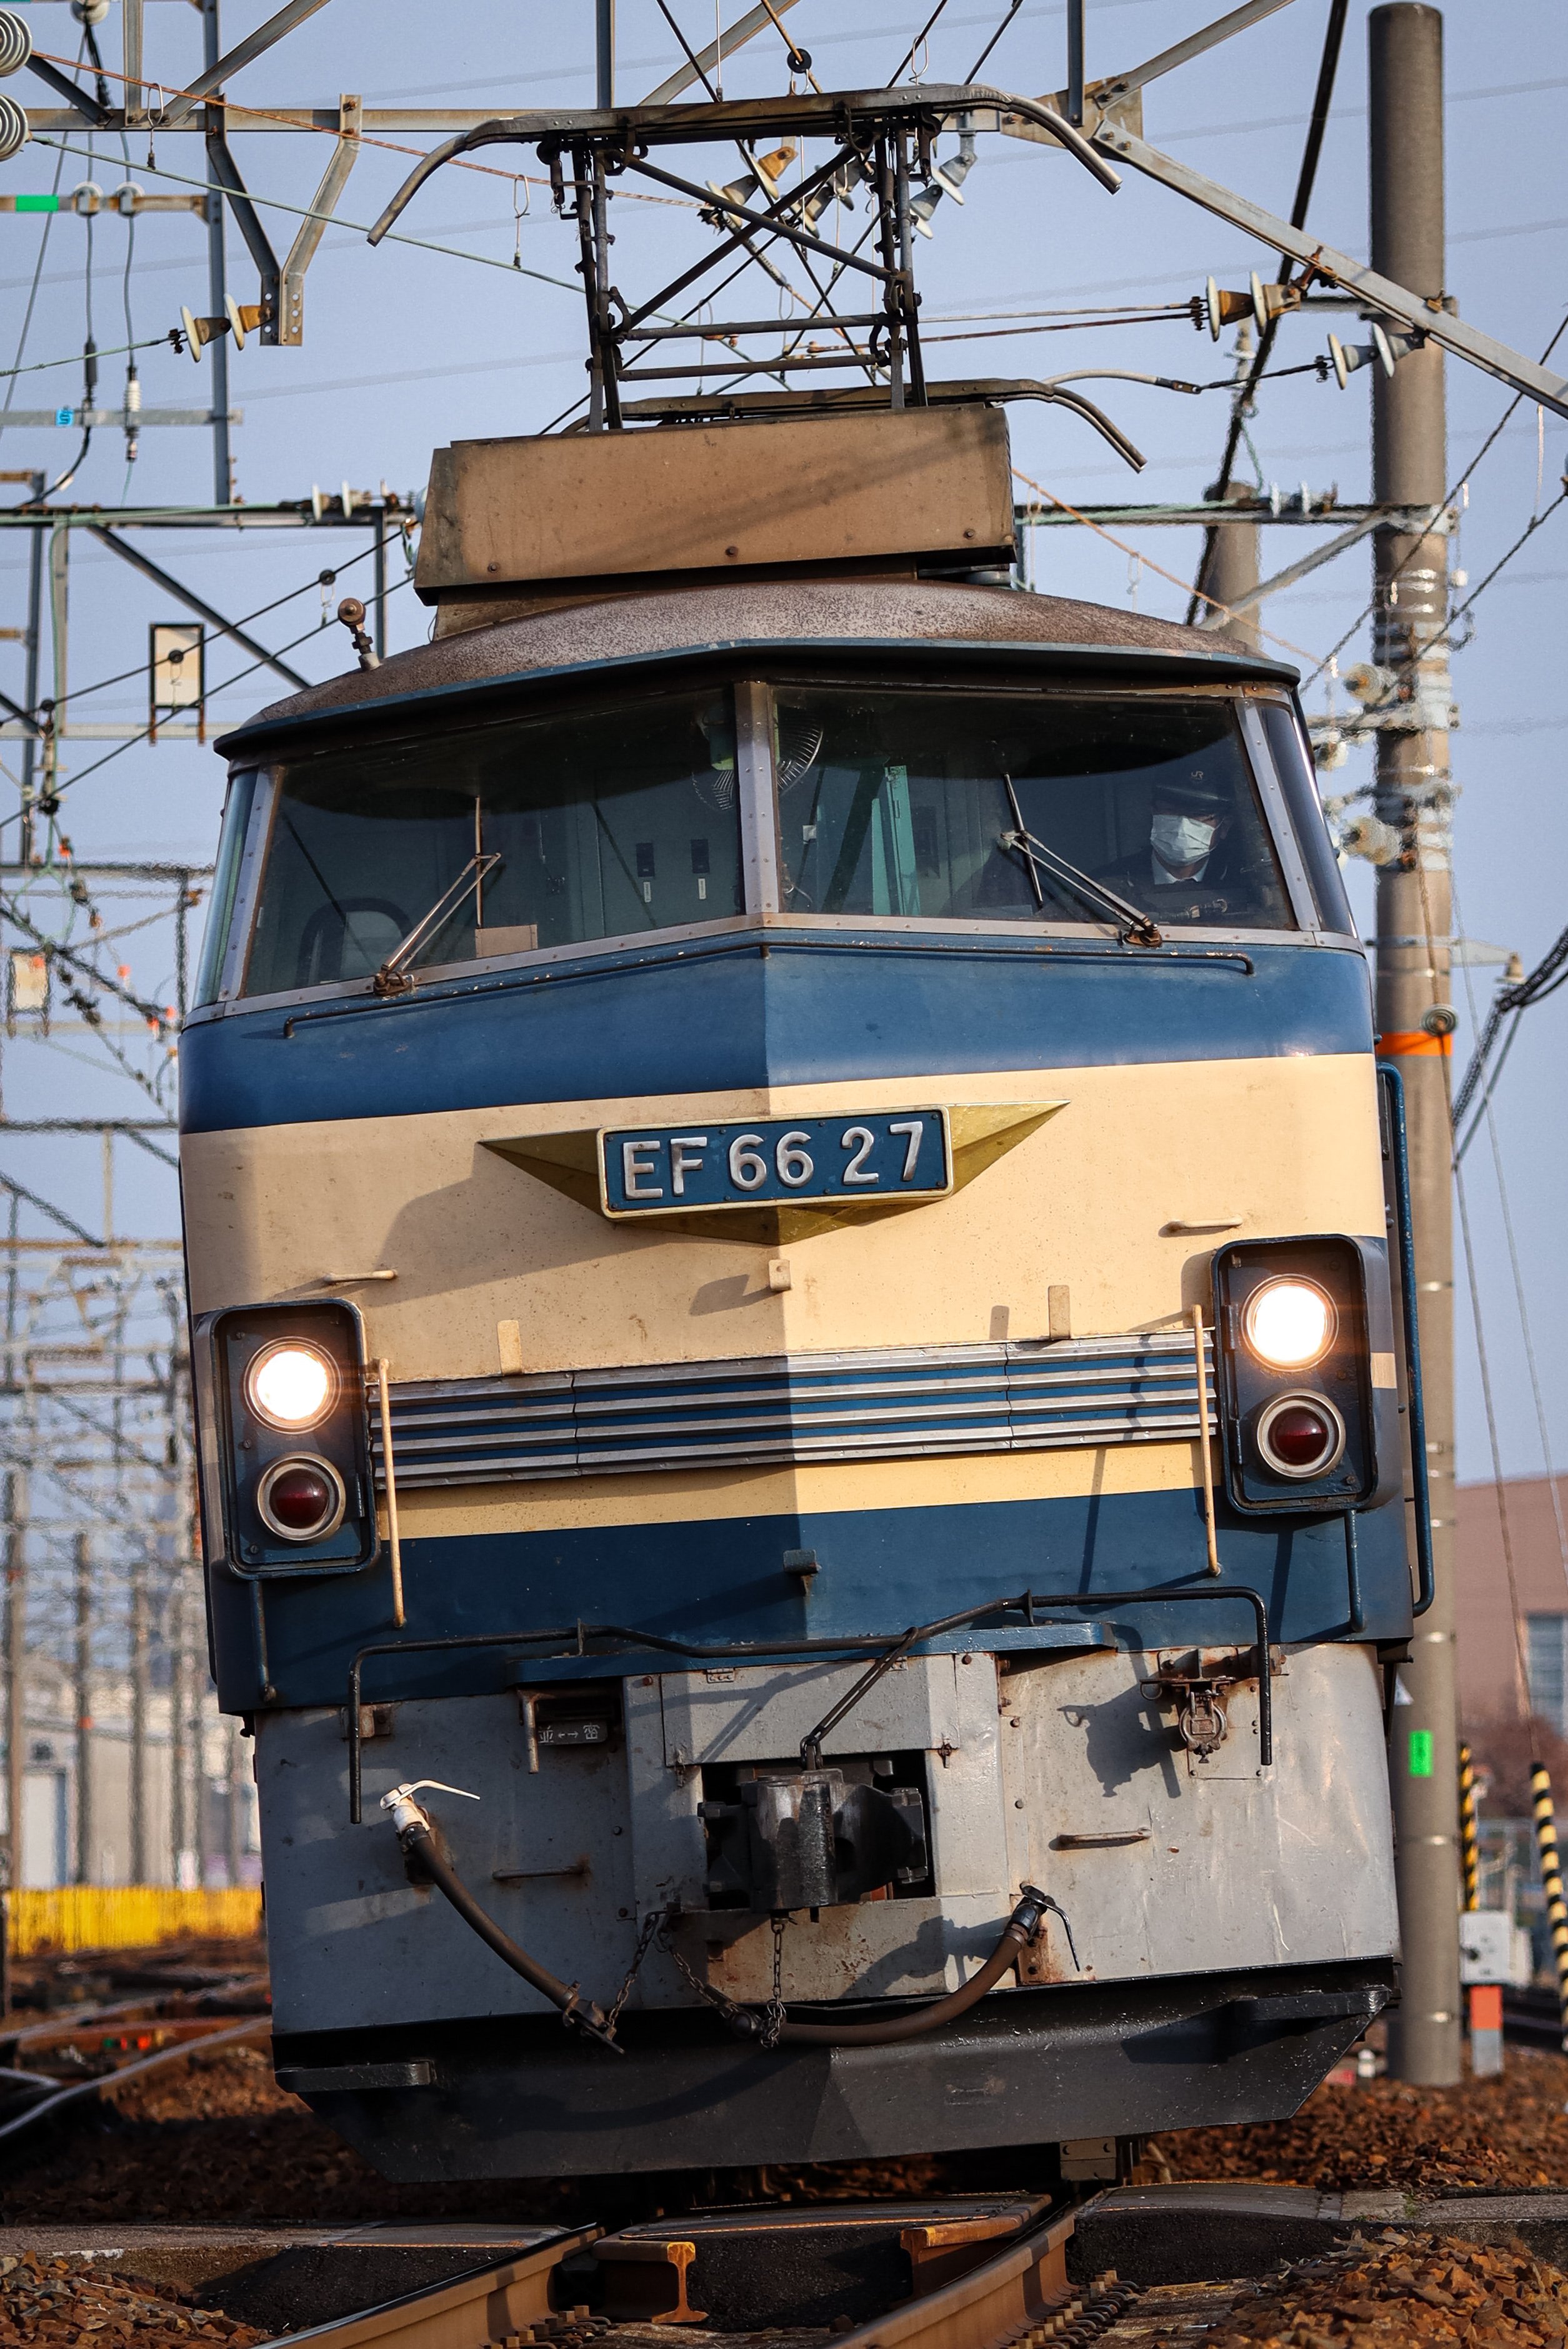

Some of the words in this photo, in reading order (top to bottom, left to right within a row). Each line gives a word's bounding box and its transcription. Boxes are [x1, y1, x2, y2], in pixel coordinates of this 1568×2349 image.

[1191, 771, 1204, 779] JR
[623, 1136, 707, 1200] EF
[729, 1131, 814, 1191] 66
[841, 1121, 924, 1185] 27
